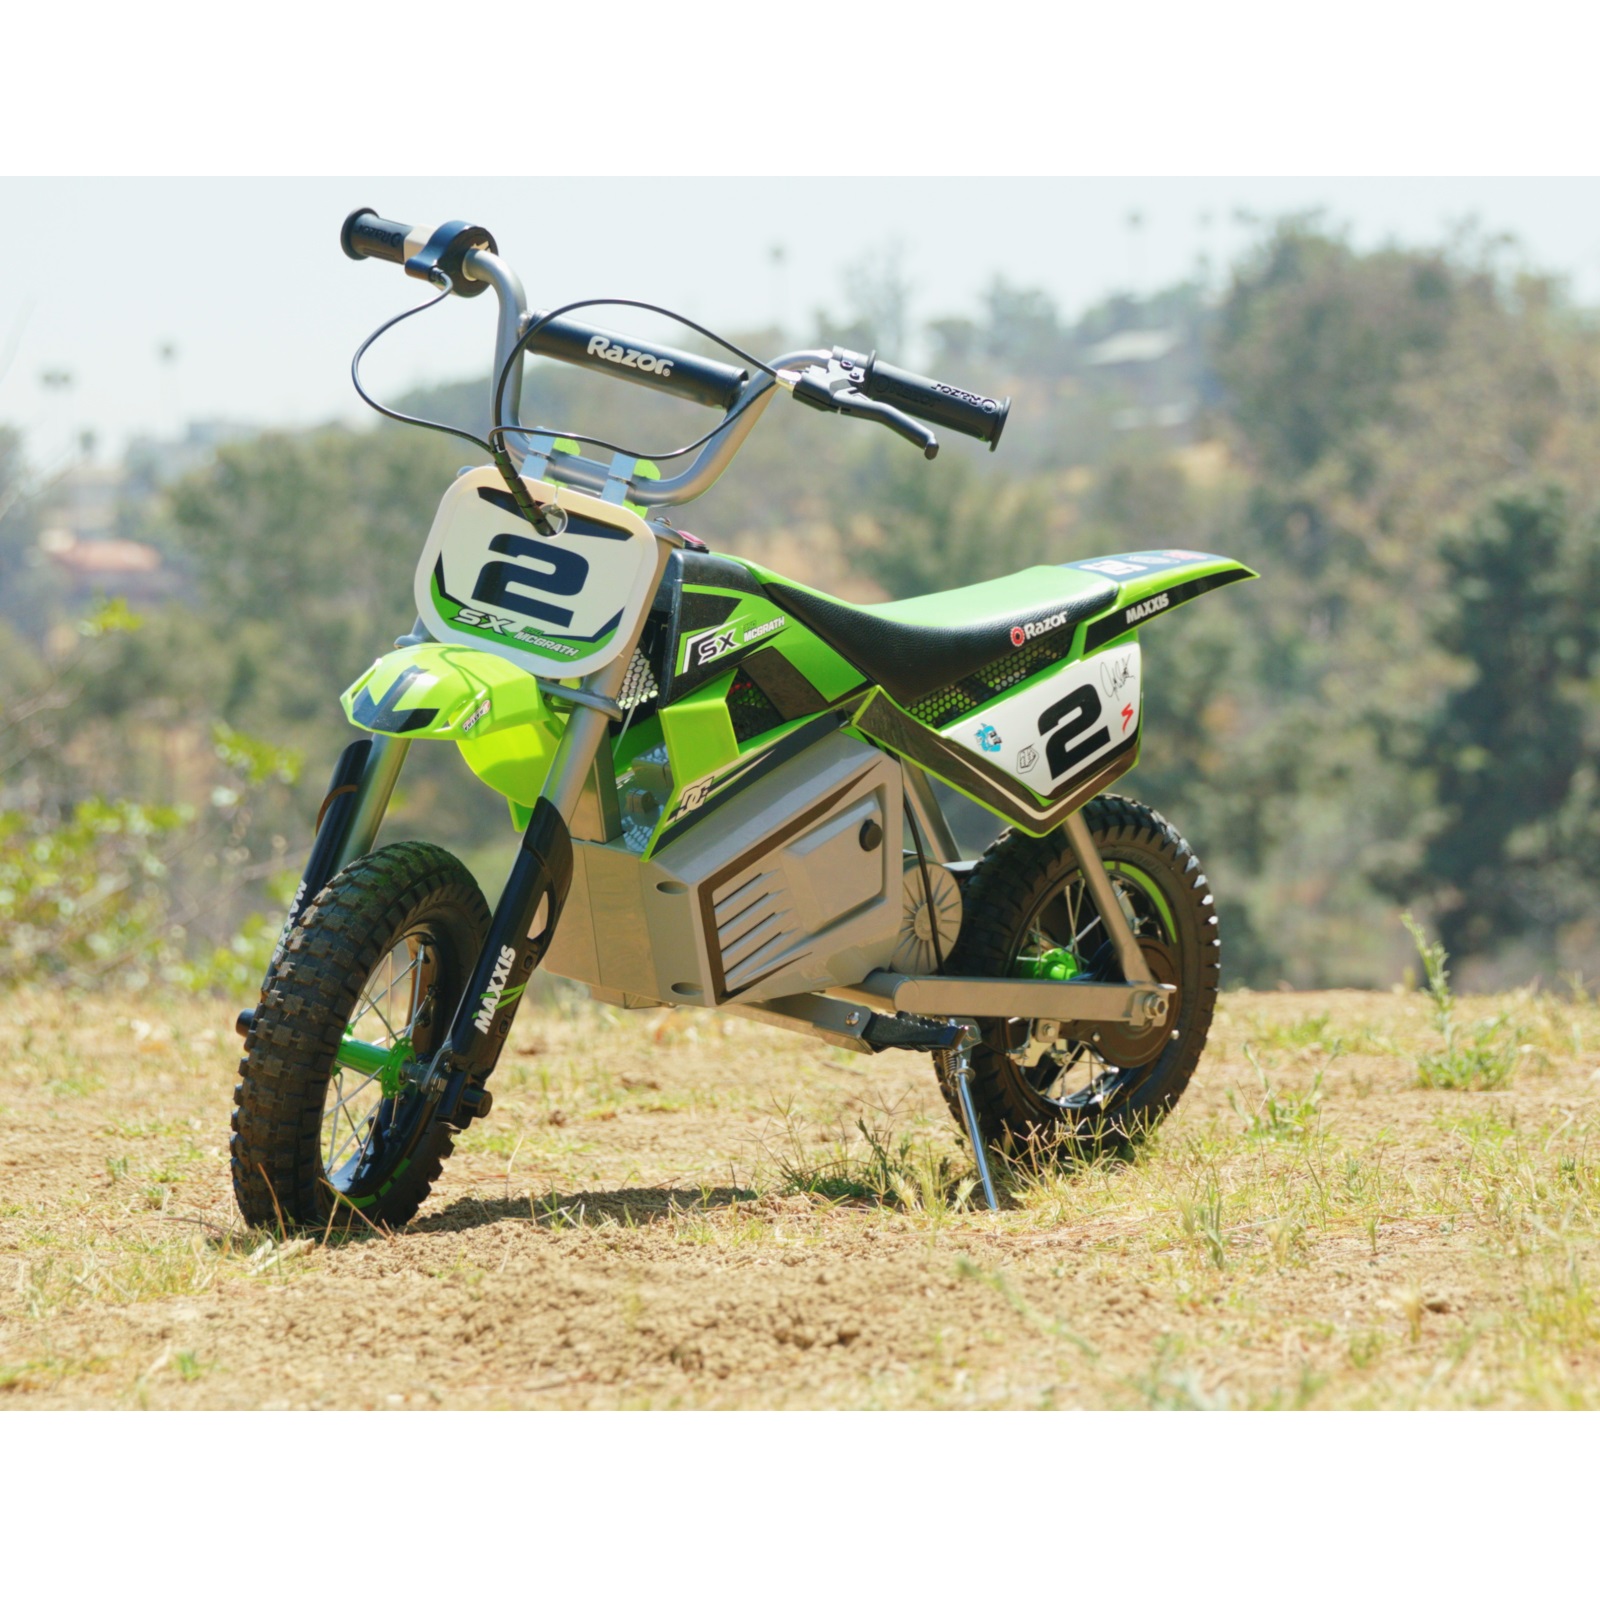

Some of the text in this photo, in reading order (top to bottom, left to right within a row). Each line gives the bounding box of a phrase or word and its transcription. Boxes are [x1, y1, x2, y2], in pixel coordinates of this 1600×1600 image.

[587, 335, 674, 375] Razor
[470, 532, 590, 629] 2
[450, 607, 580, 657] SX MCGRATH
[1023, 611, 1068, 640] Razor
[1125, 592, 1170, 625] MAXXIS
[698, 615, 785, 666] SX MCGRATH
[1037, 683, 1112, 781] 2
[474, 944, 516, 1034] MAXXIS
